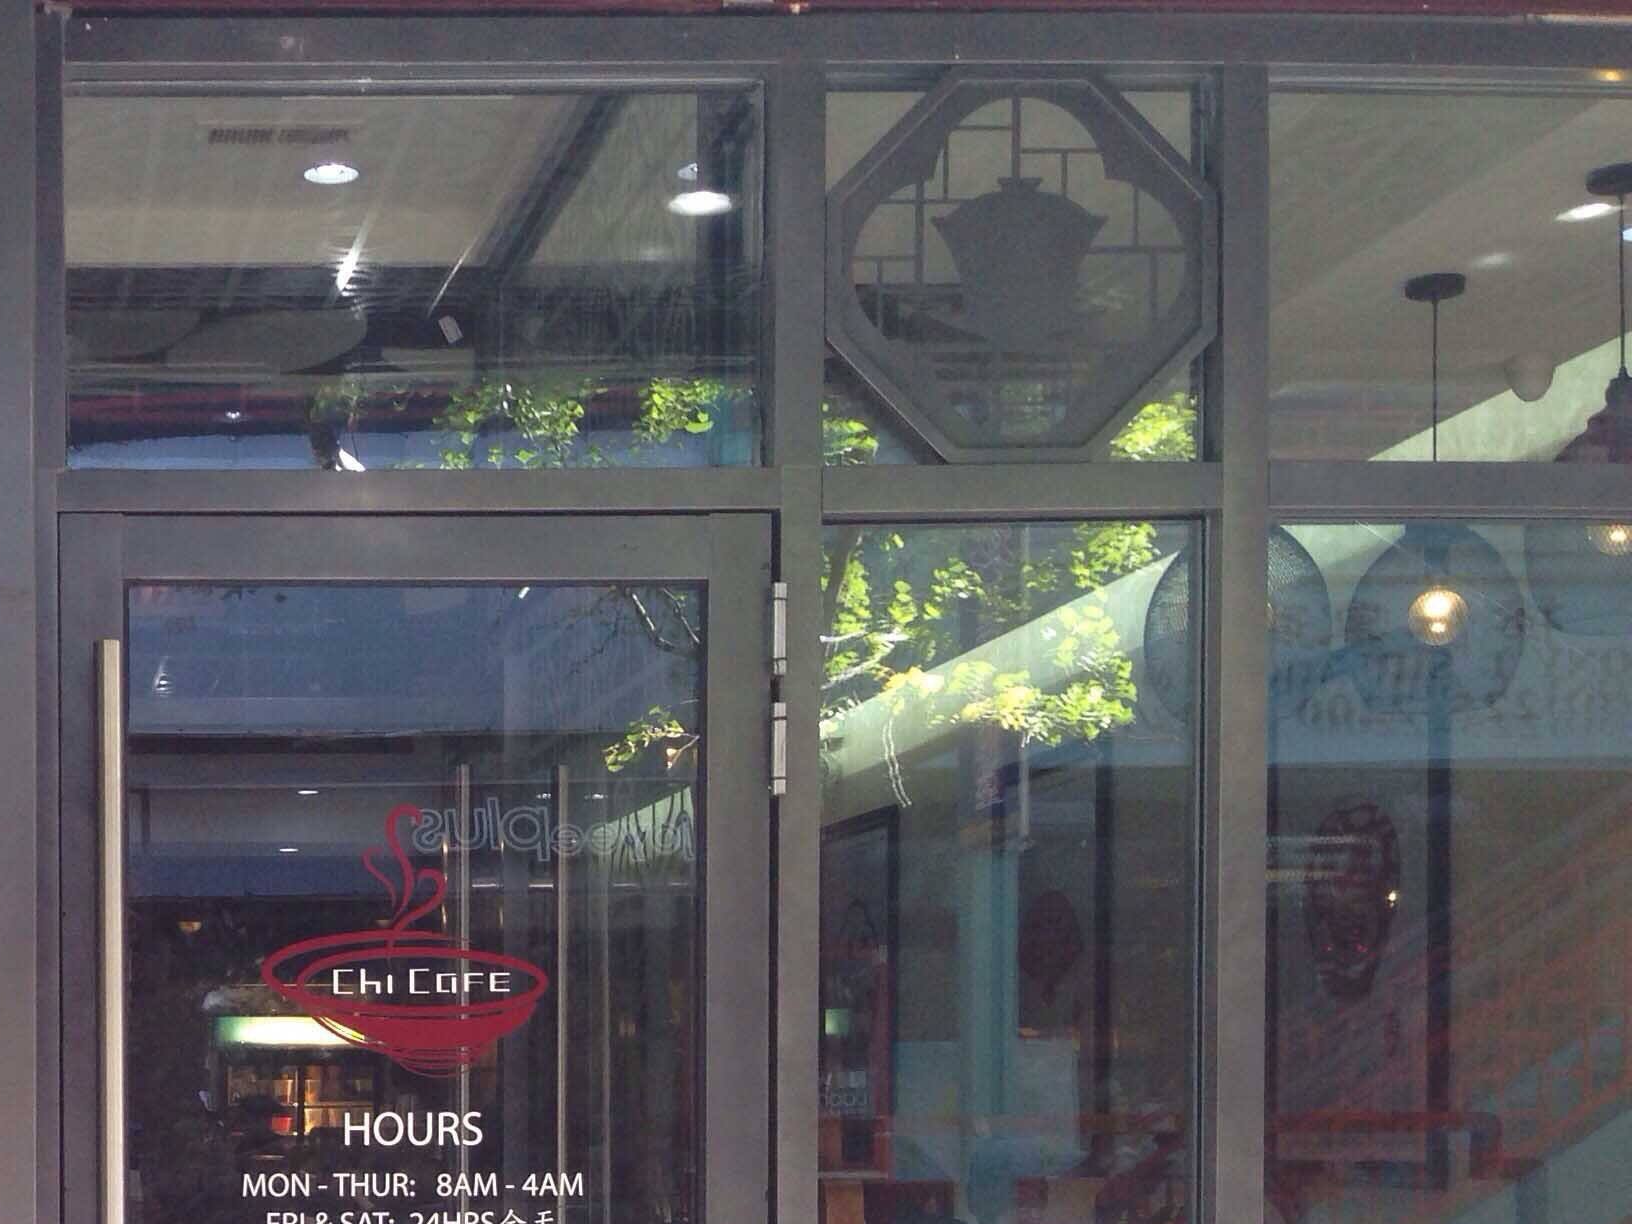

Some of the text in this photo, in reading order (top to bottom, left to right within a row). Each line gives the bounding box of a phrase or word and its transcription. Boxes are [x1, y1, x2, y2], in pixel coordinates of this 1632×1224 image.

[332, 968, 394, 995] Chi
[344, 1111, 483, 1146] HOURS
[242, 1172, 310, 1197] MON
[333, 1172, 416, 1197] THUR:
[436, 1172, 498, 1197] 8AM
[521, 1172, 584, 1197] 4AM
